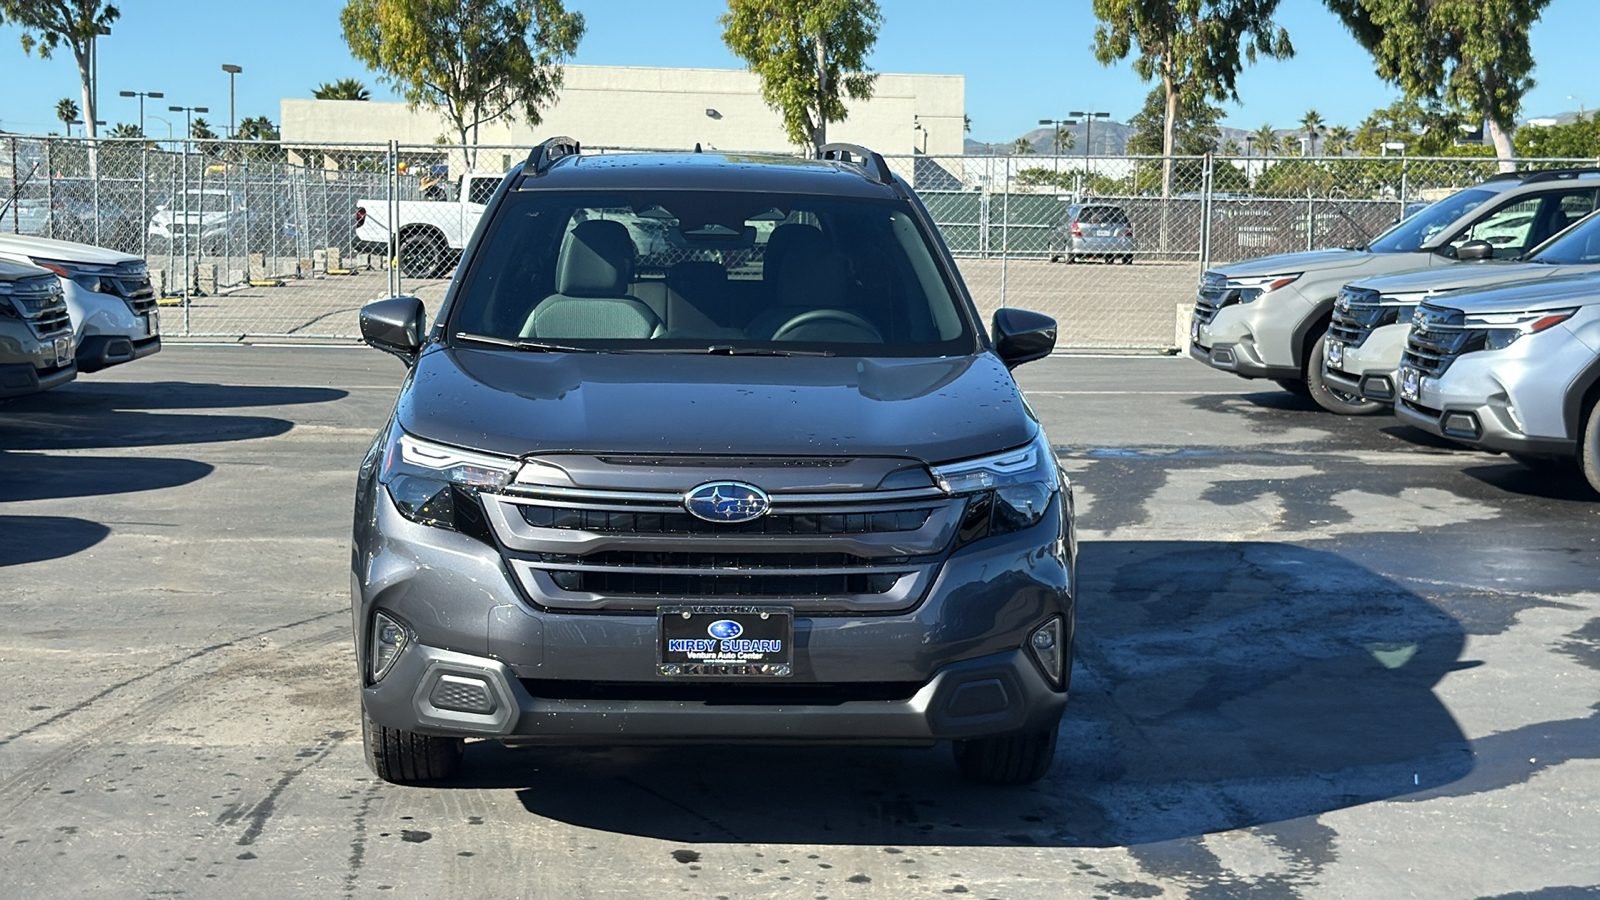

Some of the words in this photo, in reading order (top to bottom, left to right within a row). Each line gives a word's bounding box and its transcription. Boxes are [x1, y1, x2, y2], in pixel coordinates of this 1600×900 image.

[669, 639, 716, 652] KIRBY
[720, 639, 781, 652] SUBARU
[687, 651, 716, 659] Ventura
